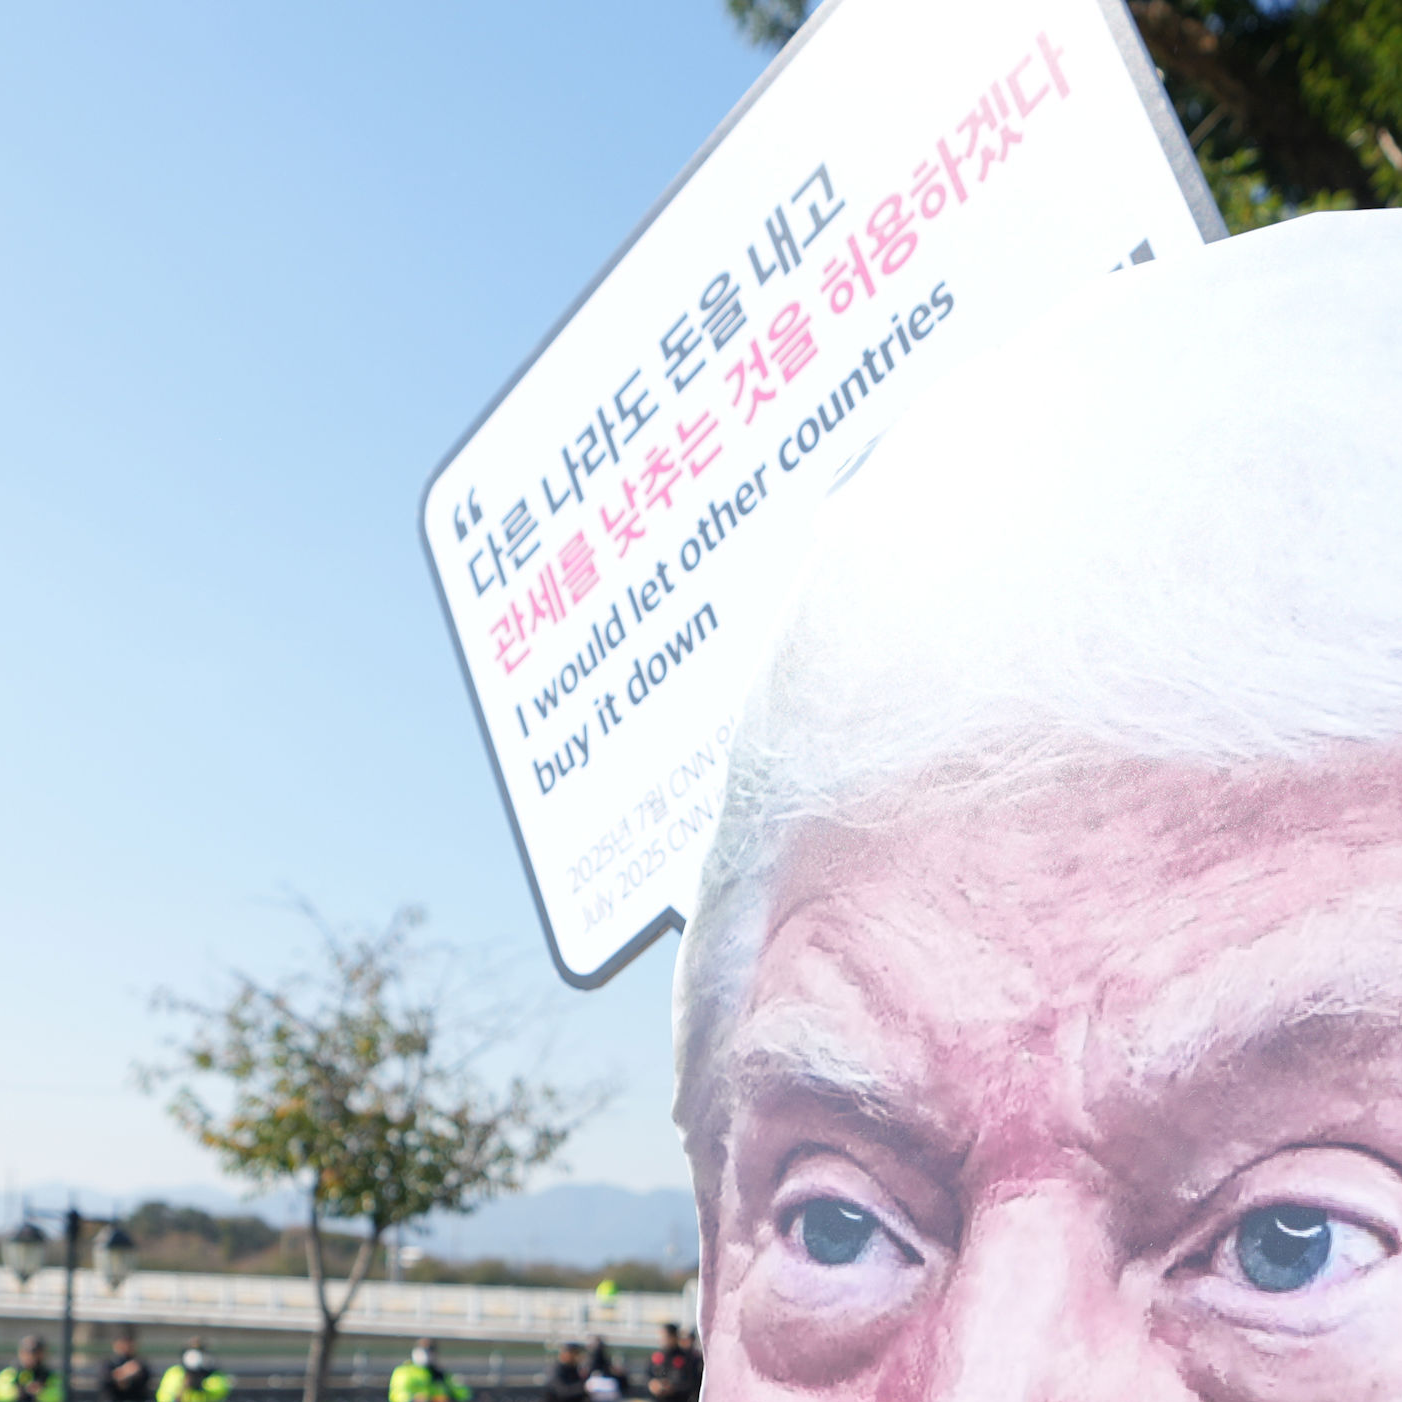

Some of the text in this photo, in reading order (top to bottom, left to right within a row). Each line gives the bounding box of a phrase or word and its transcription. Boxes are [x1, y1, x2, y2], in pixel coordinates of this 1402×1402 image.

[467, 161, 846, 597] 다른 나라도 돈을 내고
[488, 29, 1071, 676] 관세를 낮추는 것을 허용하겠다
[514, 279, 955, 739] I would let other countries
[531, 600, 719, 797] buy it down
